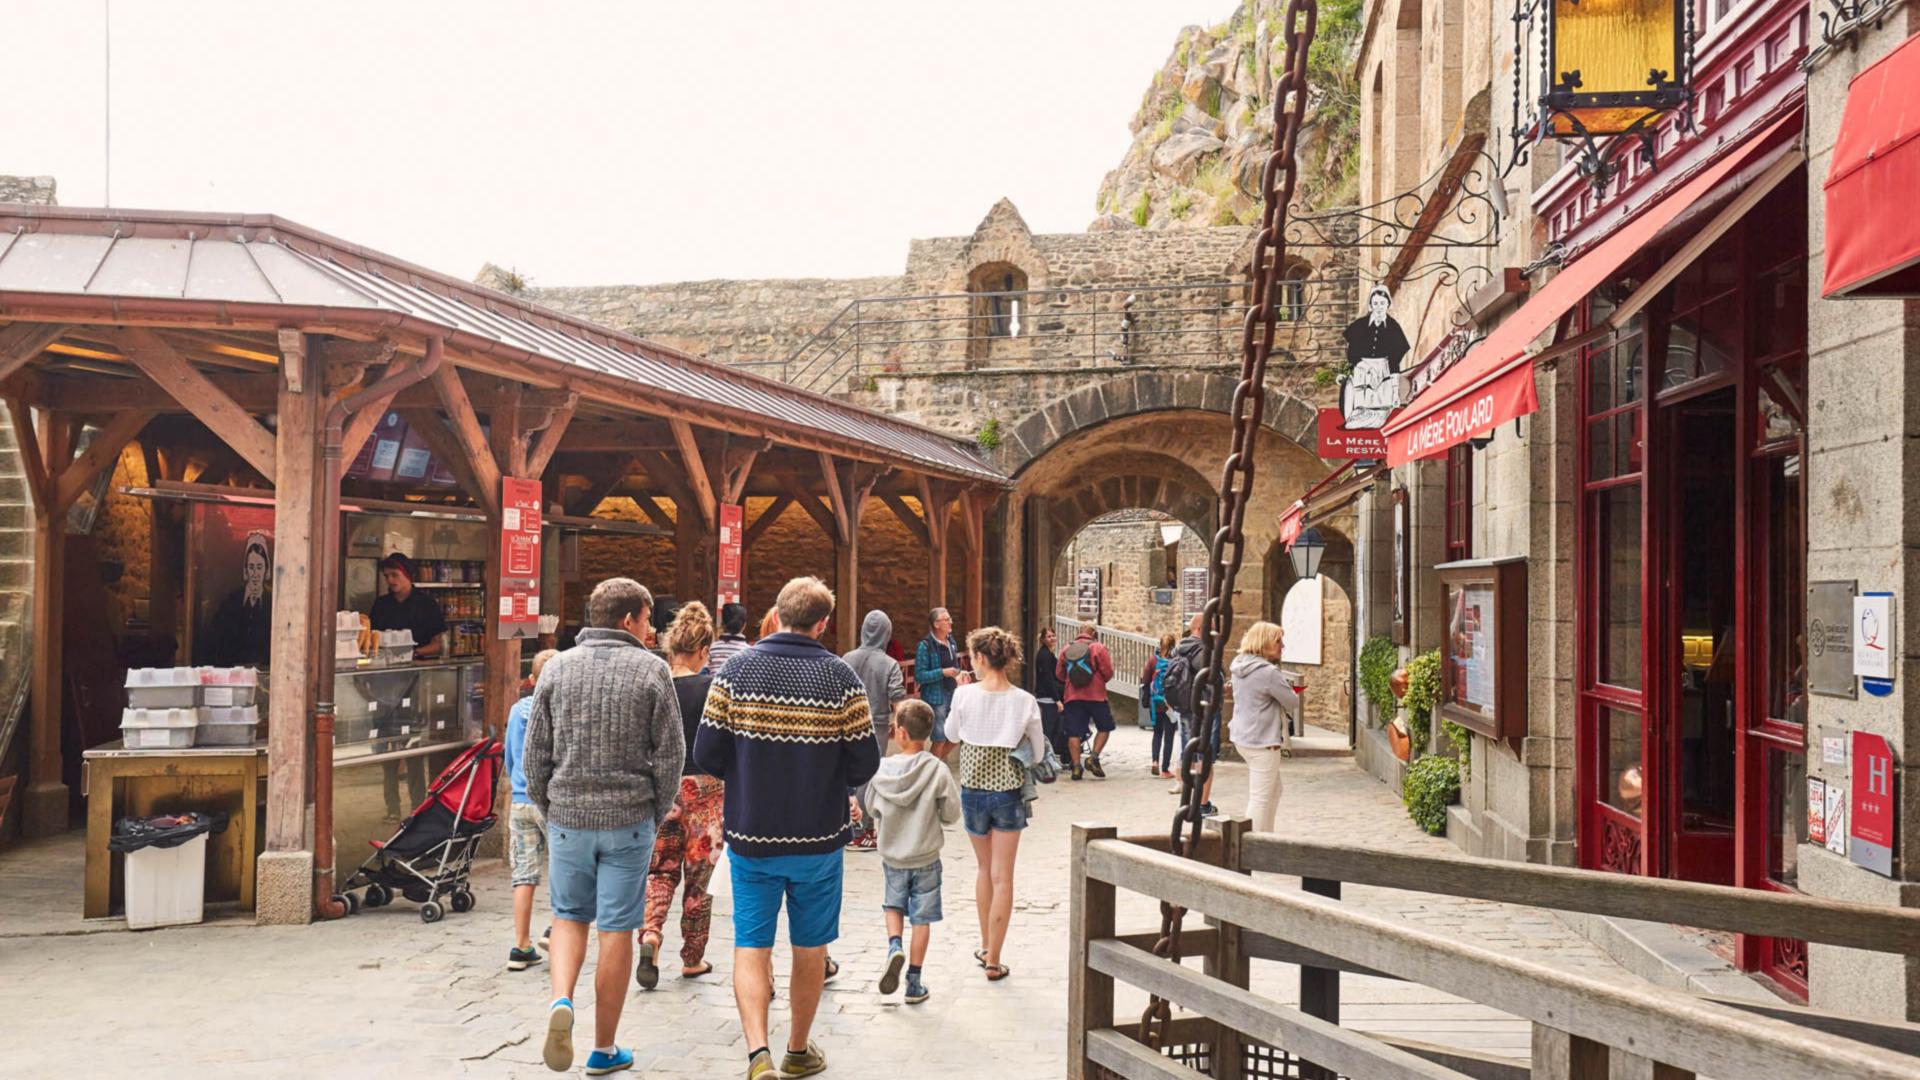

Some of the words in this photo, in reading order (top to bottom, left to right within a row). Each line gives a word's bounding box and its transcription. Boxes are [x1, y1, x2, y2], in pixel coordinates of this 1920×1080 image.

[1407, 431, 1418, 456] LA
[1419, 416, 1445, 450] MÈRE
[1446, 395, 1494, 441] POULARD
[1346, 447, 1389, 455] RESTAU
[1868, 754, 1889, 797] H
